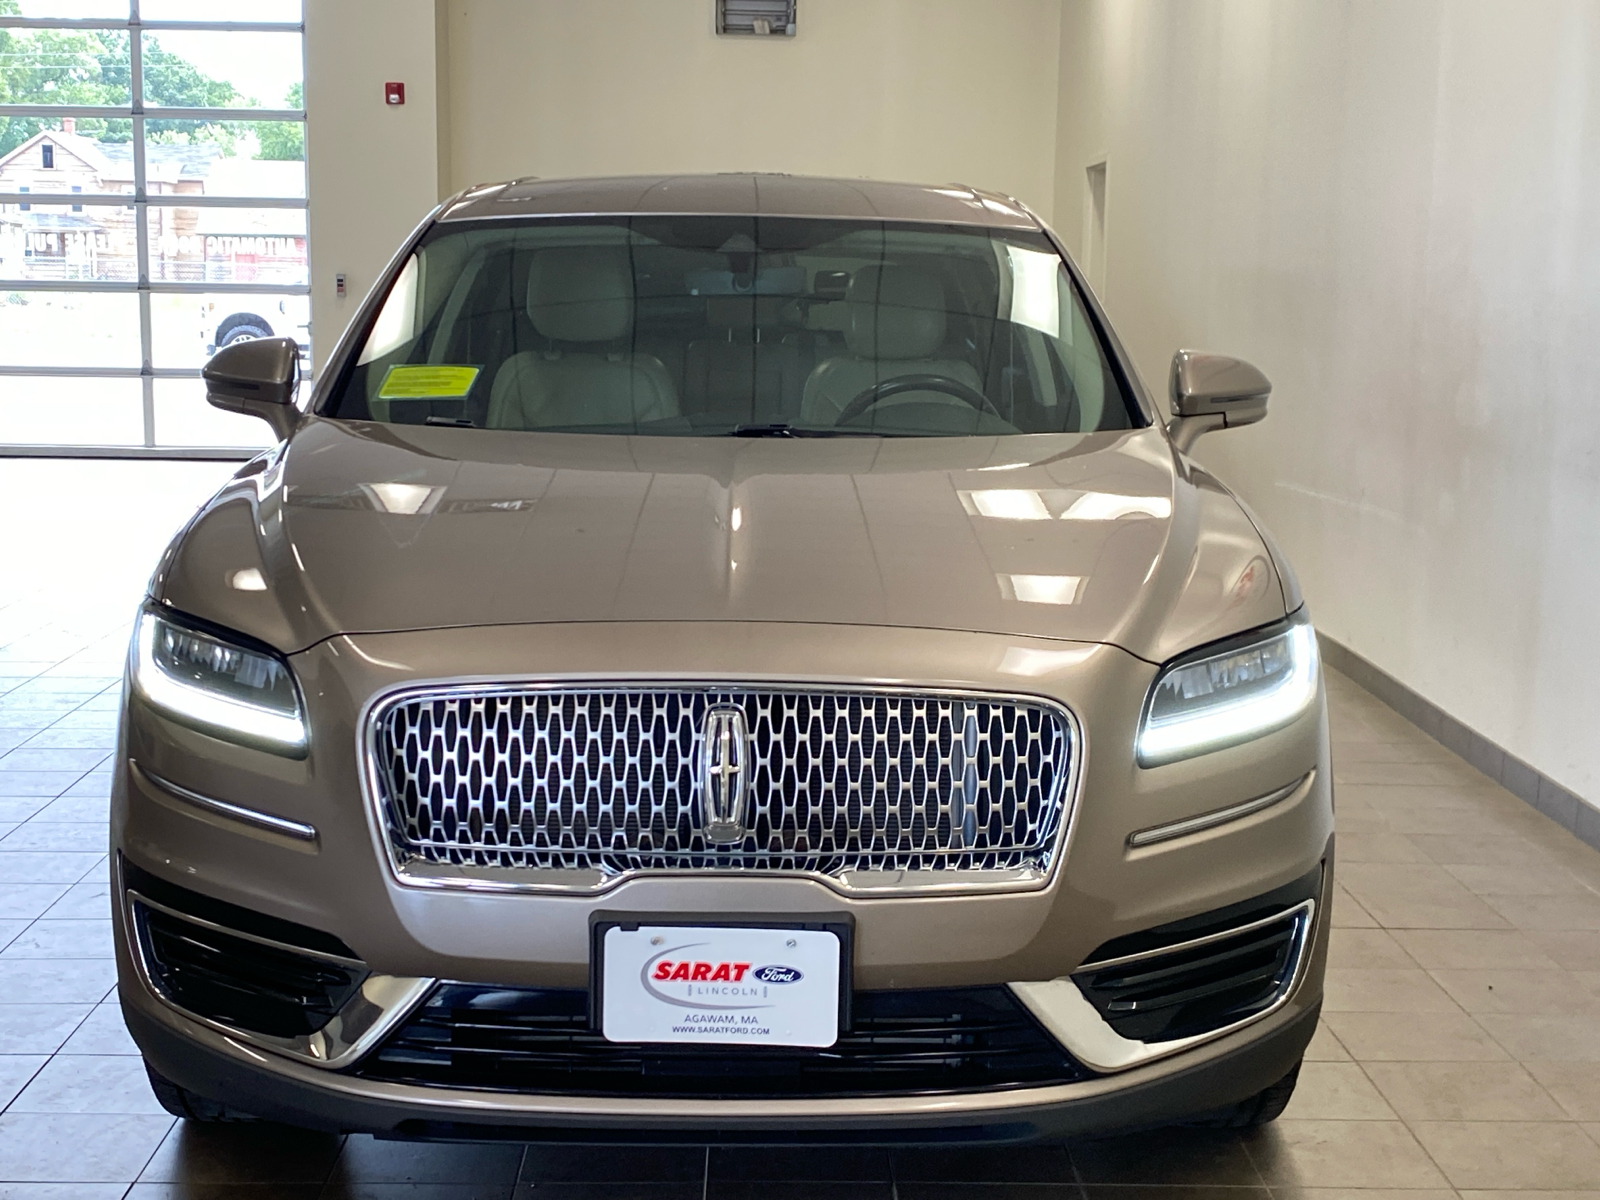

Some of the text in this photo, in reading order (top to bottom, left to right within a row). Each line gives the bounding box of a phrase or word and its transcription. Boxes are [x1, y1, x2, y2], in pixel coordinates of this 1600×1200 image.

[652, 960, 795, 982] SARAT Ford
[697, 986, 758, 996] LINCOLN
[684, 1014, 758, 1025] AGAWAM, MA
[672, 1026, 770, 1035] WWW.SARATFORD.COM
